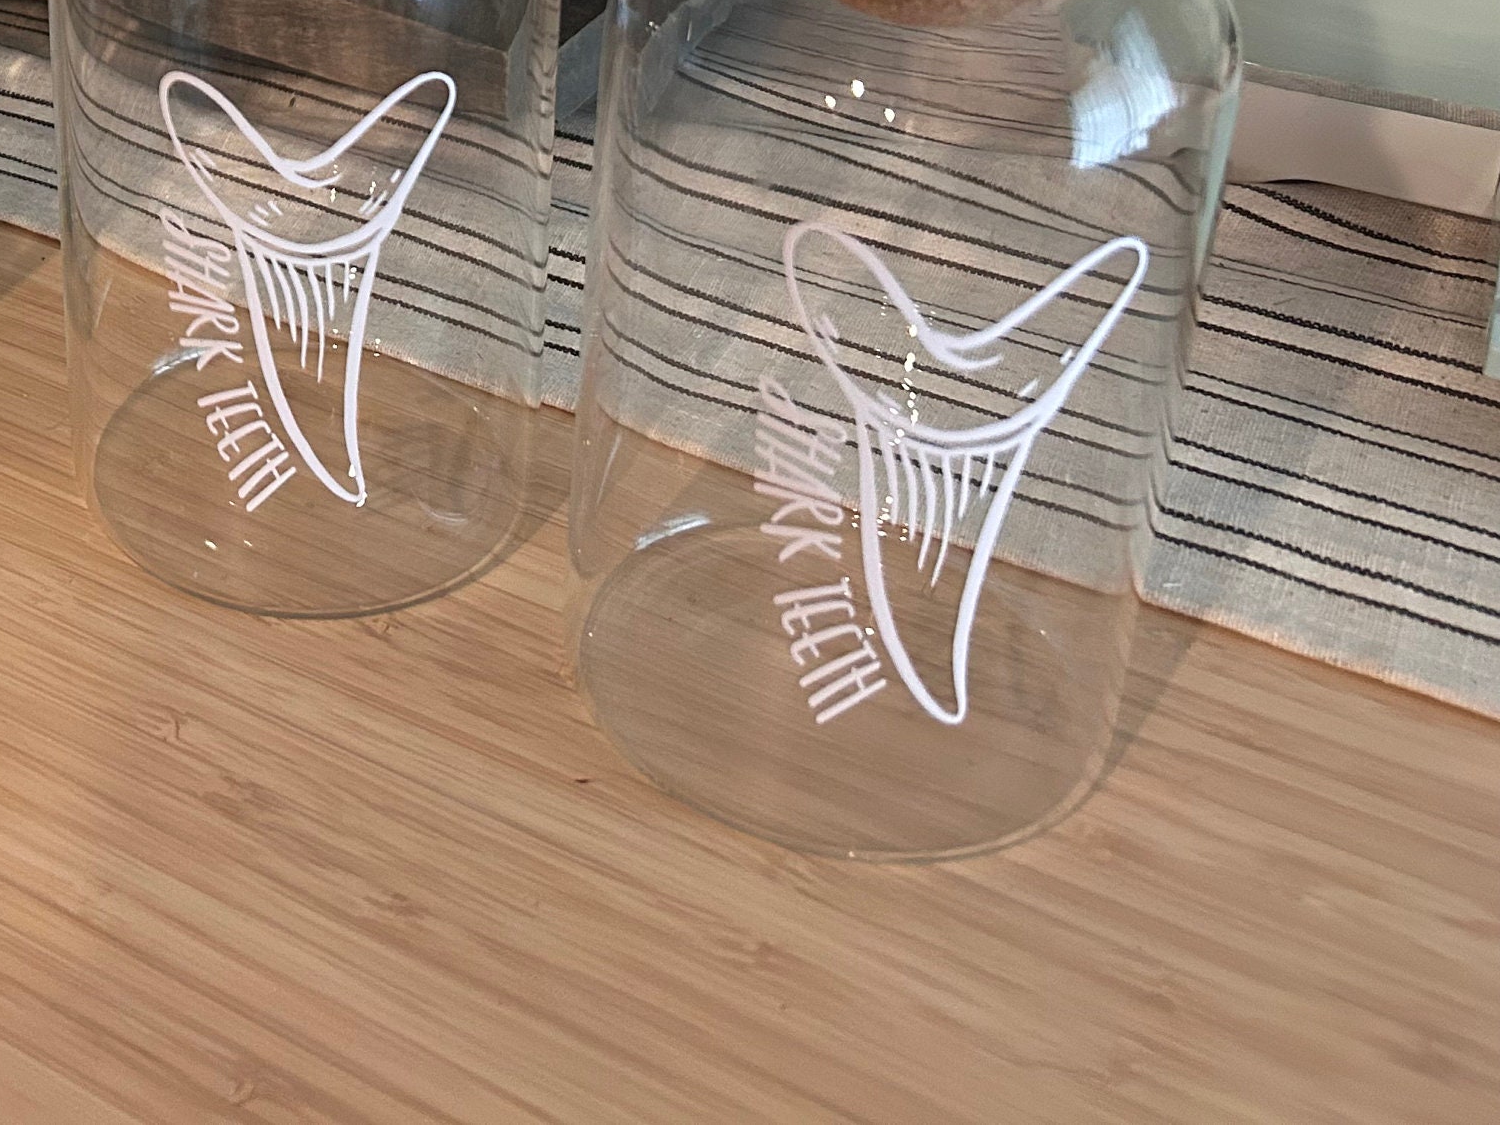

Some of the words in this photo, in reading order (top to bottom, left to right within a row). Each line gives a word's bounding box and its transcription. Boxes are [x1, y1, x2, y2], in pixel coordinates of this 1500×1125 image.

[159, 209, 243, 371] SHARK
[197, 380, 297, 512] TEETH
[753, 378, 847, 562] SHARK
[773, 576, 886, 725] TEETH
